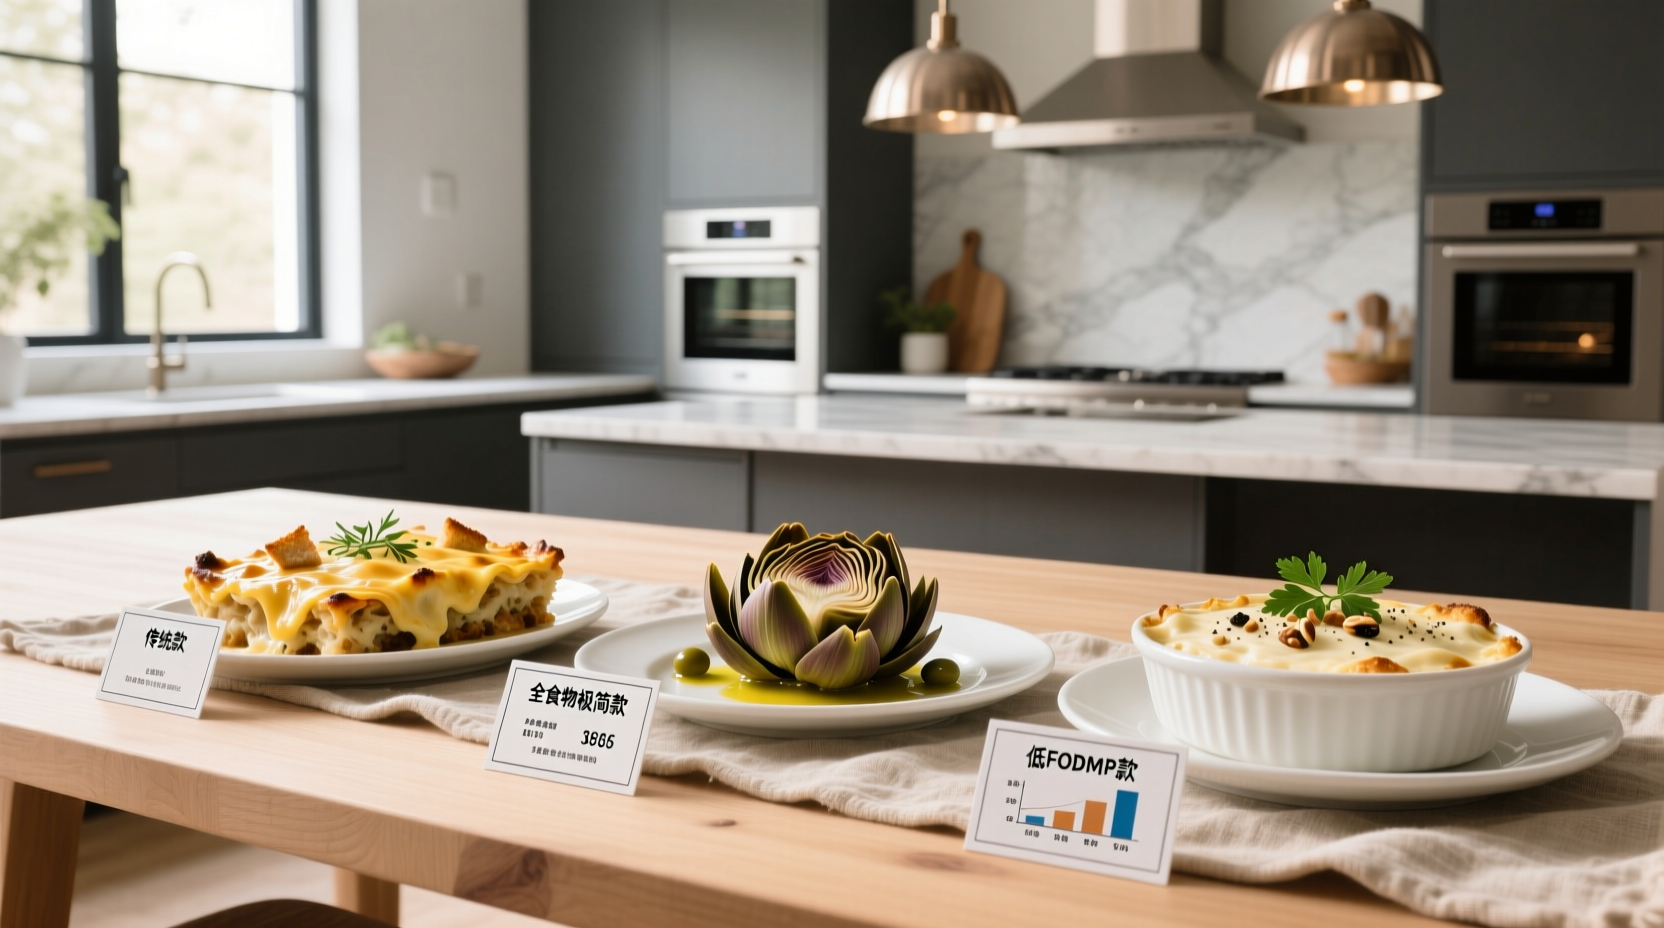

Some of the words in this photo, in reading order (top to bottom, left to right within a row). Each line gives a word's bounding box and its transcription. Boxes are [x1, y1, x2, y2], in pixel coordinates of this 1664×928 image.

[145, 627, 188, 653] 传统款
[1026, 744, 1139, 782] 低FODMP款
